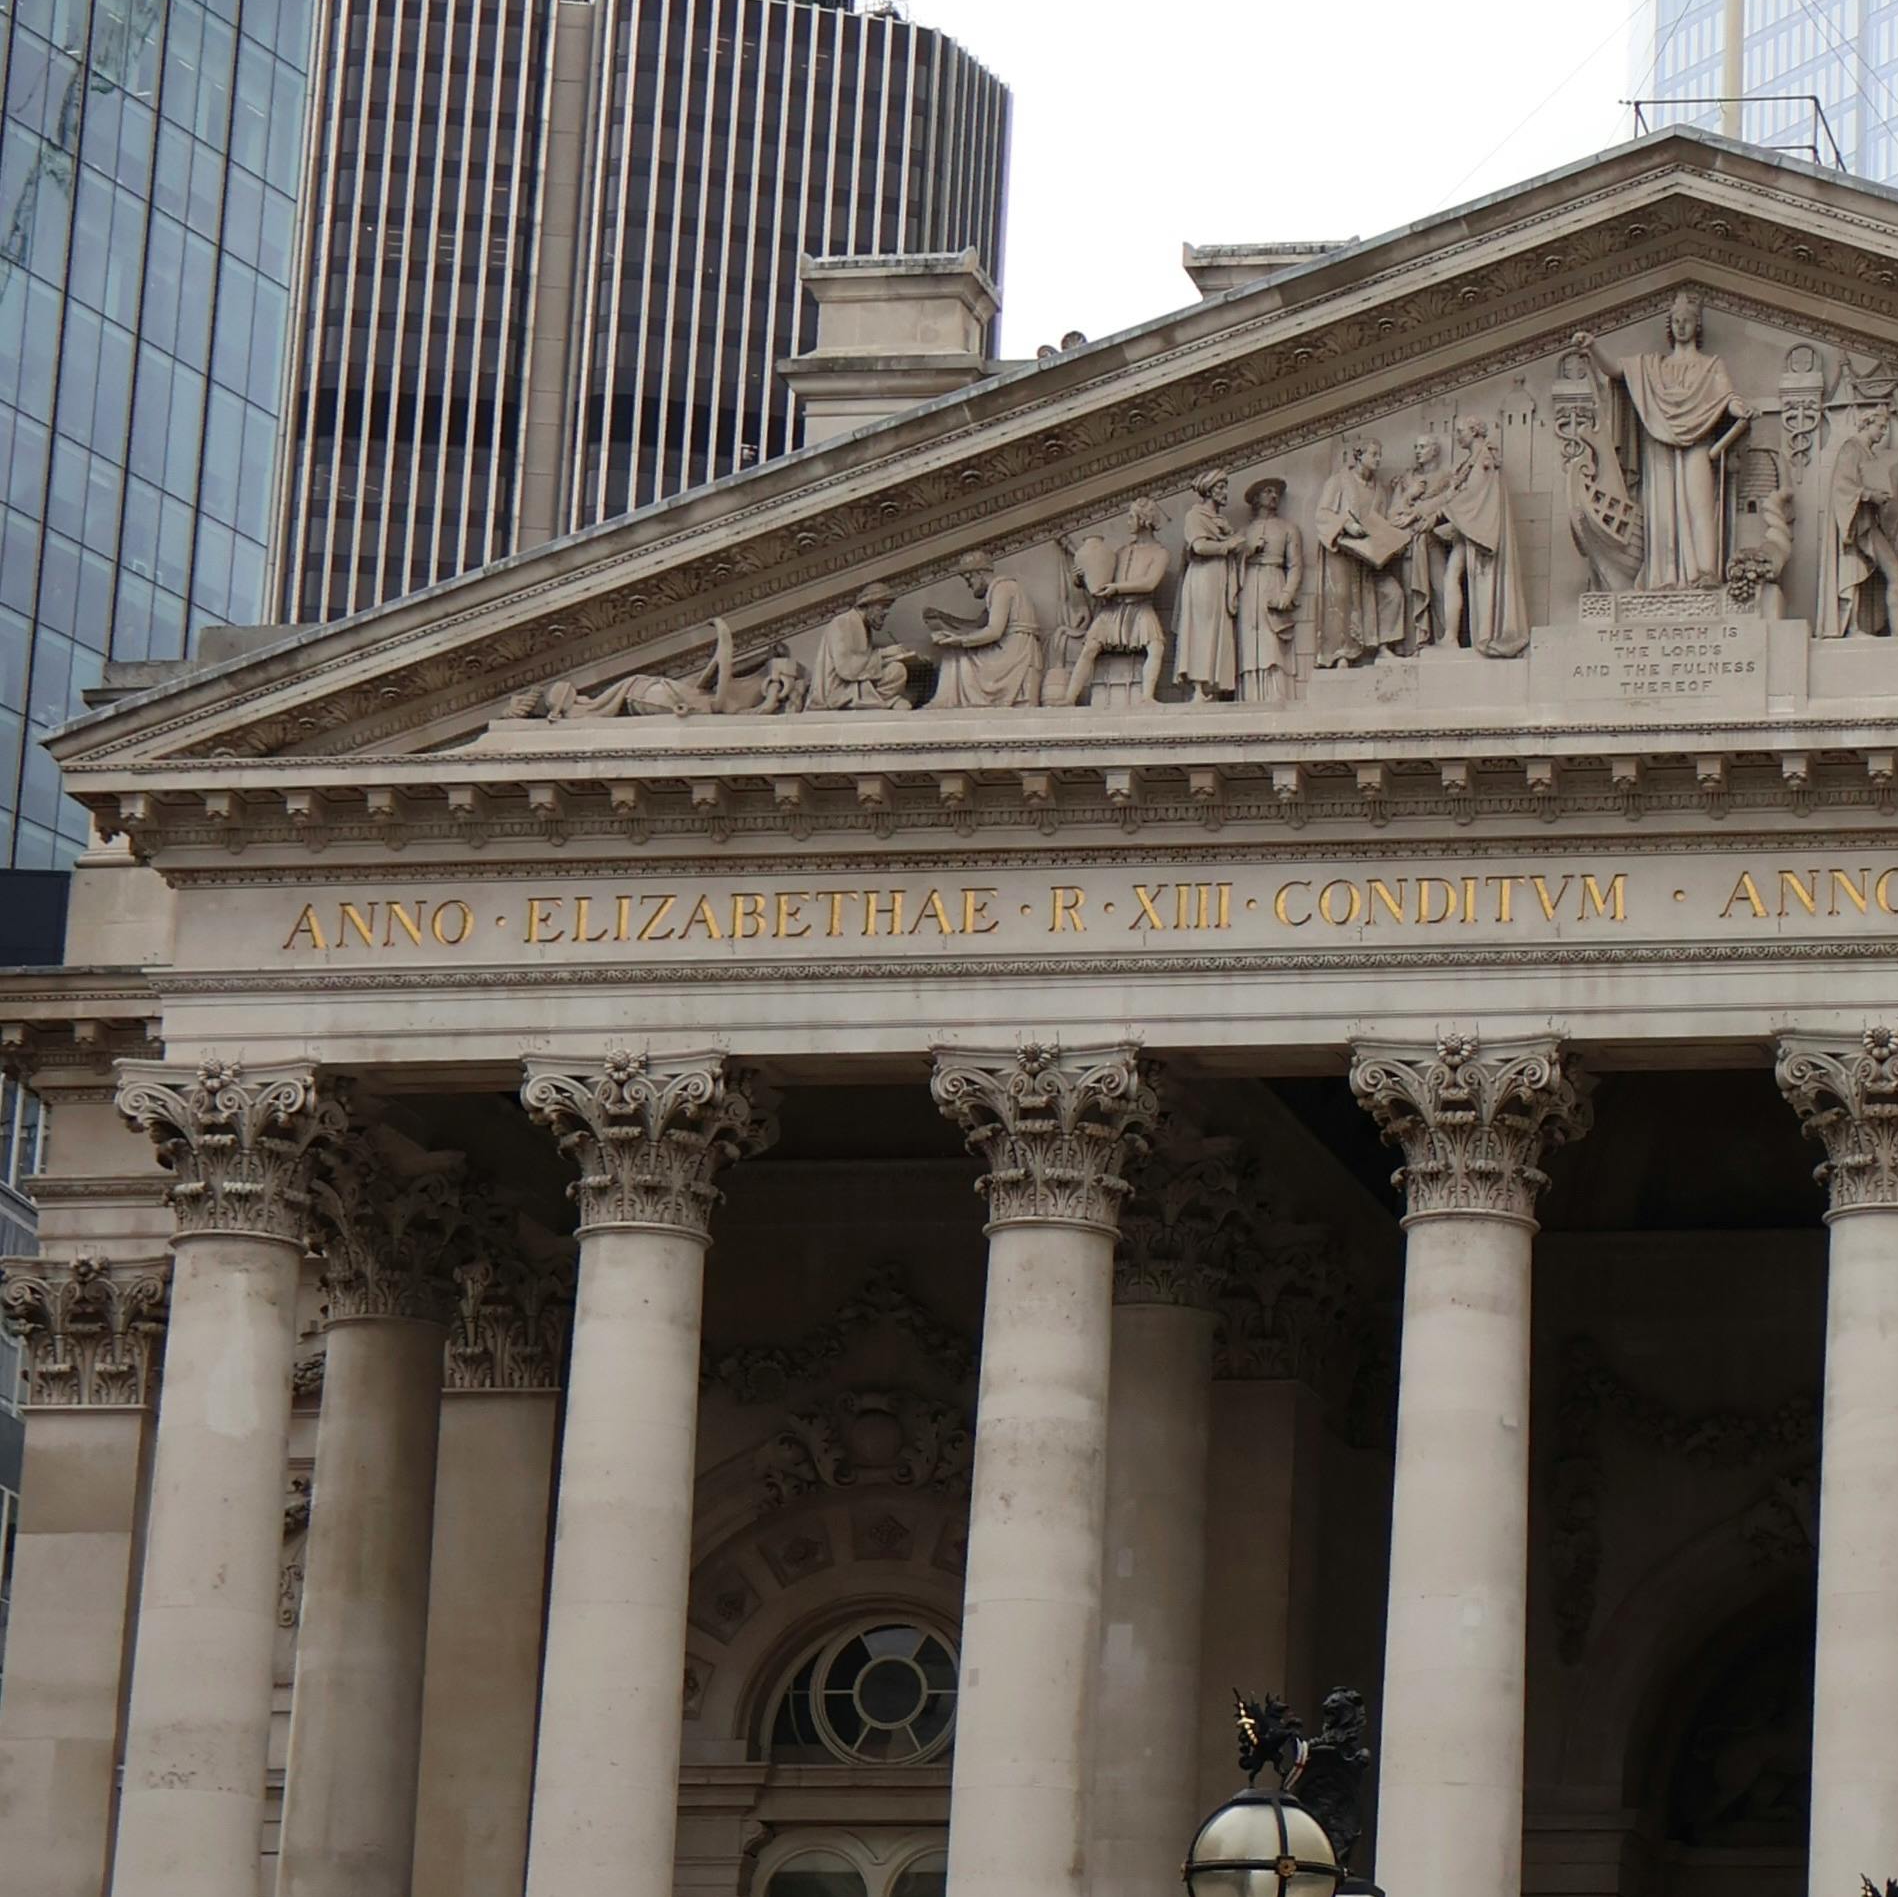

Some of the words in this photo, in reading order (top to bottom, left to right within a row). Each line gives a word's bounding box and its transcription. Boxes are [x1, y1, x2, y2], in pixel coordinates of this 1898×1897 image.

[1597, 628, 1633, 642] THE
[1645, 626, 1709, 641] EARTH
[1721, 626, 1739, 639] IS
[1613, 645, 1649, 659] THE
[1661, 644, 1723, 658] LORD'S
[1572, 664, 1610, 678] AND
[1623, 663, 1661, 677] THE
[1671, 660, 1756, 676] FULNESS
[1620, 680, 1713, 695] THEREOF
[282, 899, 475, 949] ANNO
[523, 887, 999, 944] ELIZABETHAE
[1048, 885, 1088, 933] R
[1128, 882, 1233, 931] XIII
[1273, 873, 1629, 927] CONDITVM
